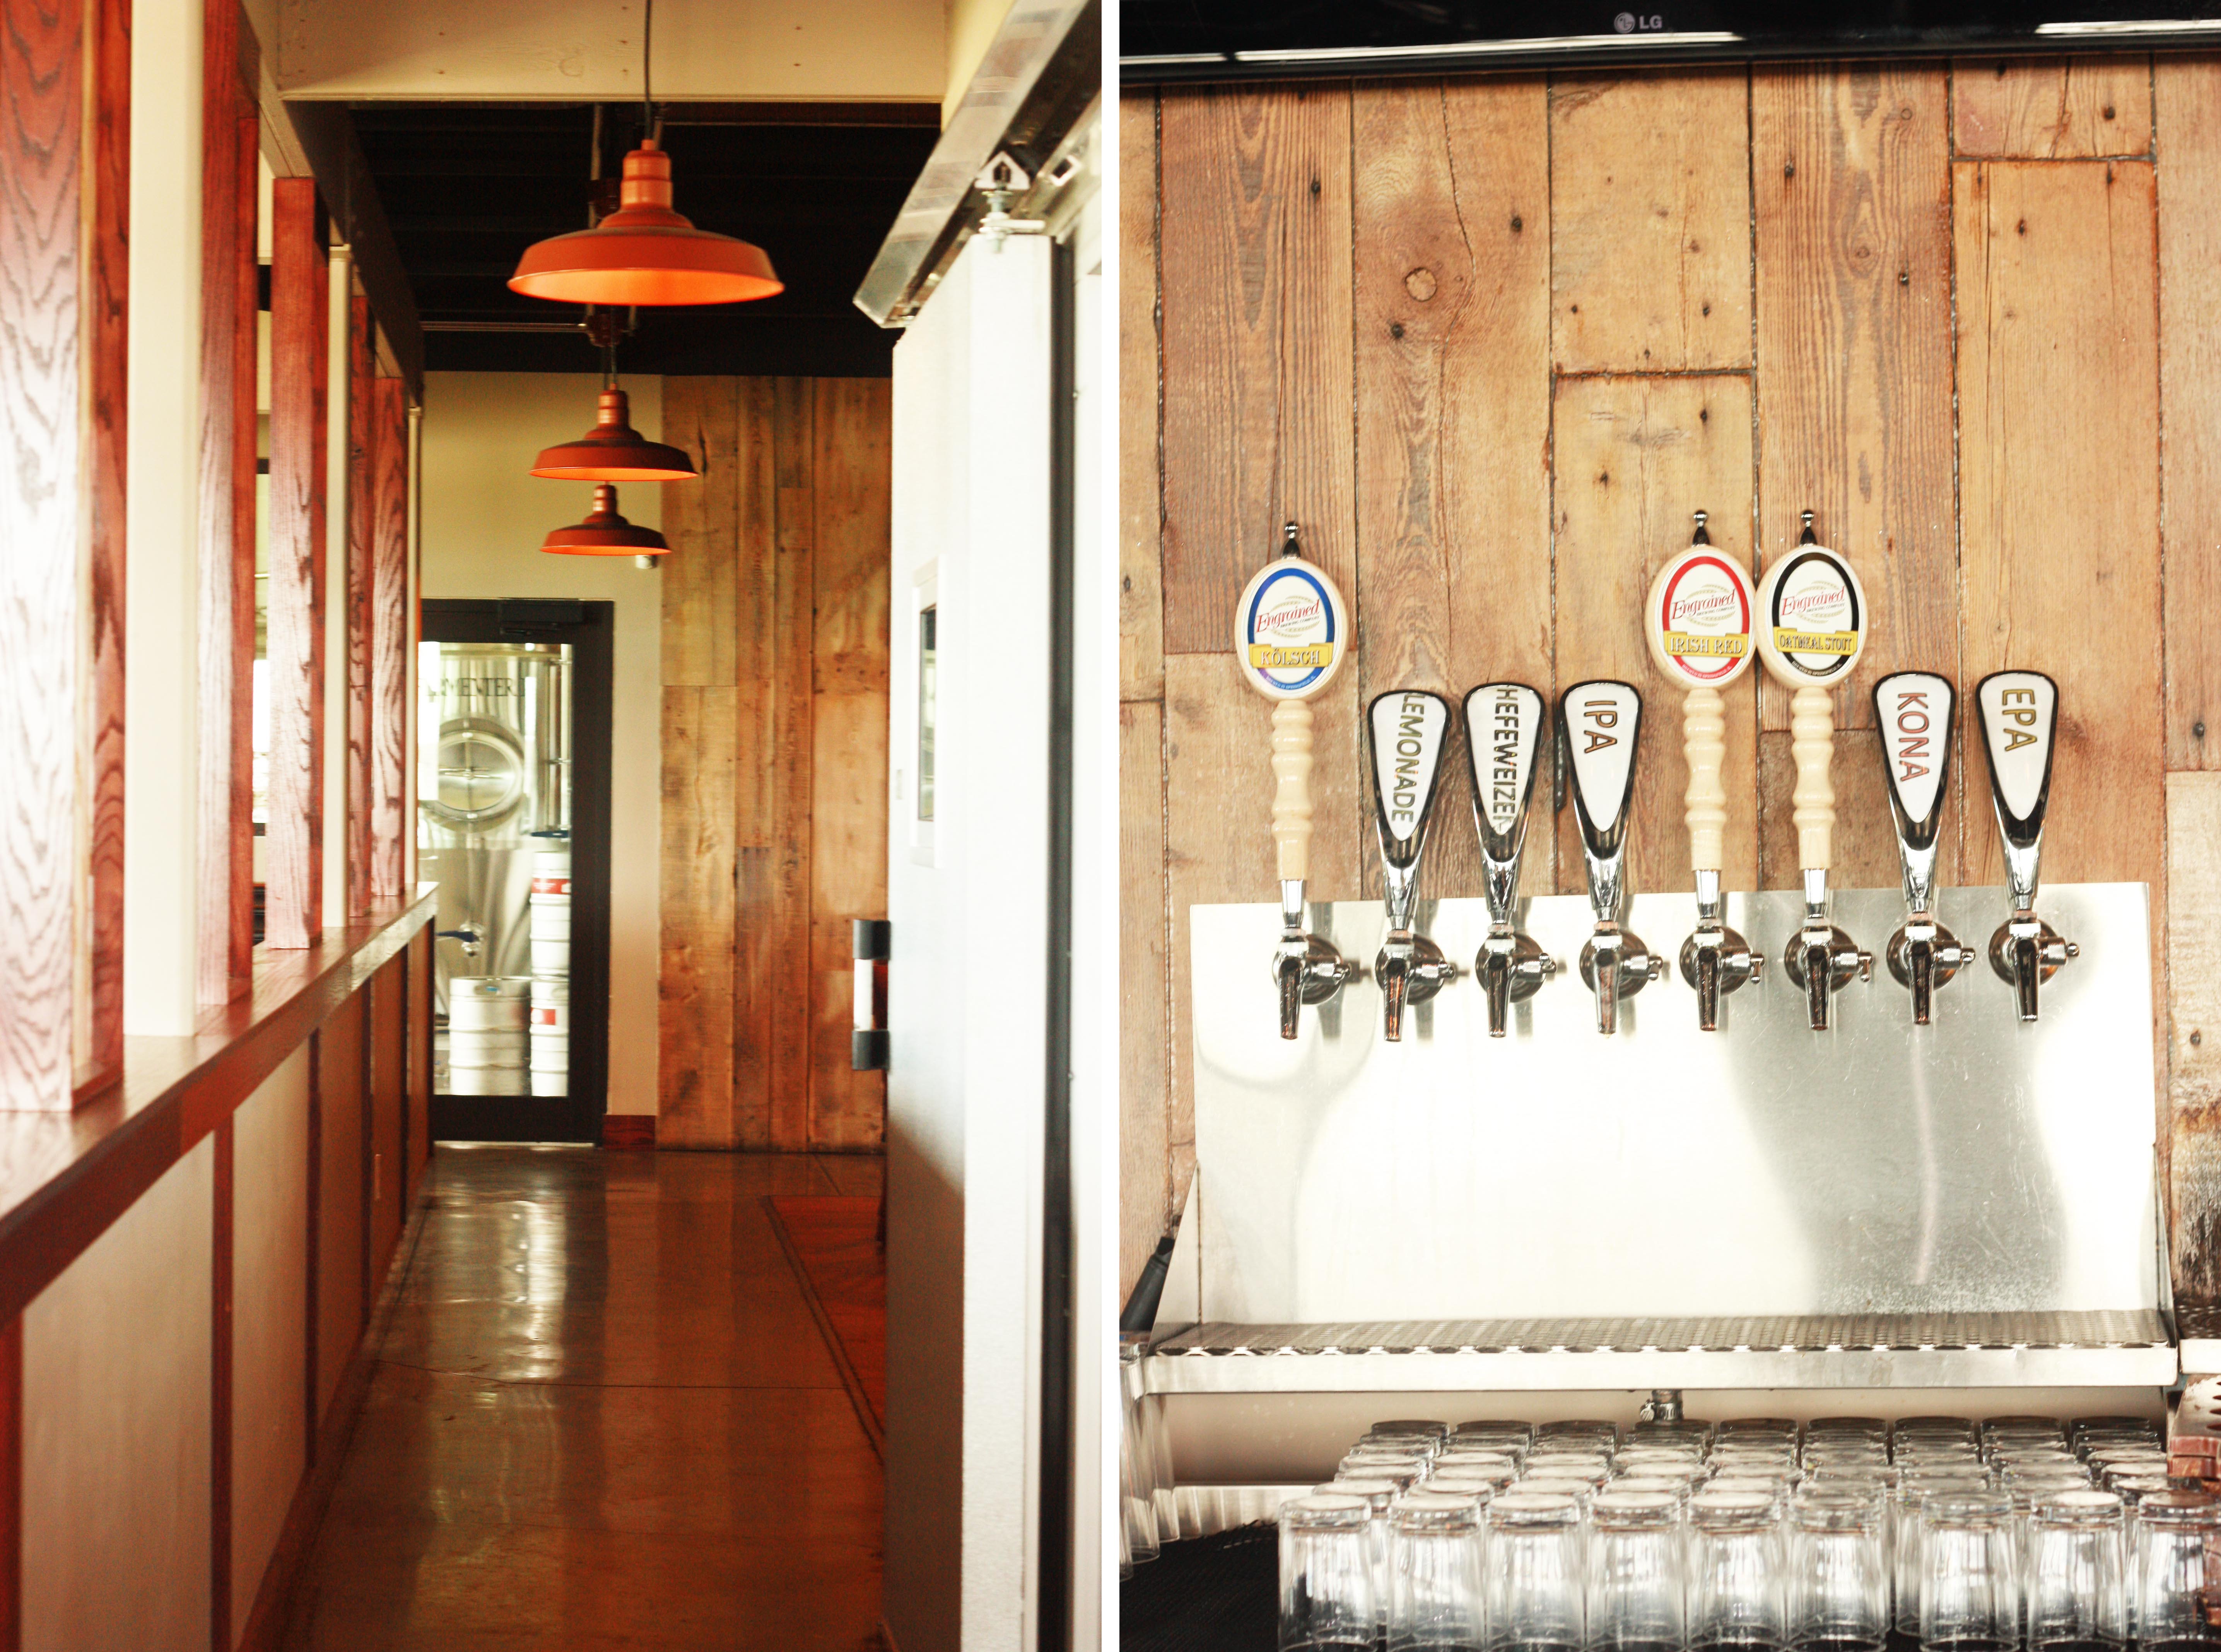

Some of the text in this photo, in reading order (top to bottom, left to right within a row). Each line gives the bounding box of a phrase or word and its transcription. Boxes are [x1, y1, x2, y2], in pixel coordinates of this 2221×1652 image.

[1639, 15, 1662, 29] LG
[1256, 598, 1320, 633] Engrained
[1671, 588, 1736, 620] Engrained
[1780, 585, 1845, 616] Engrained
[1260, 648, 1320, 666] KÖLSCH
[1669, 637, 1743, 655] IRISH RED
[1779, 634, 1852, 651] OATMEAL STOUT
[1583, 700, 1618, 754] IPA
[2002, 689, 2038, 752] EPA
[1897, 693, 1930, 782] KONA
[1391, 693, 1425, 823] LEMONADE
